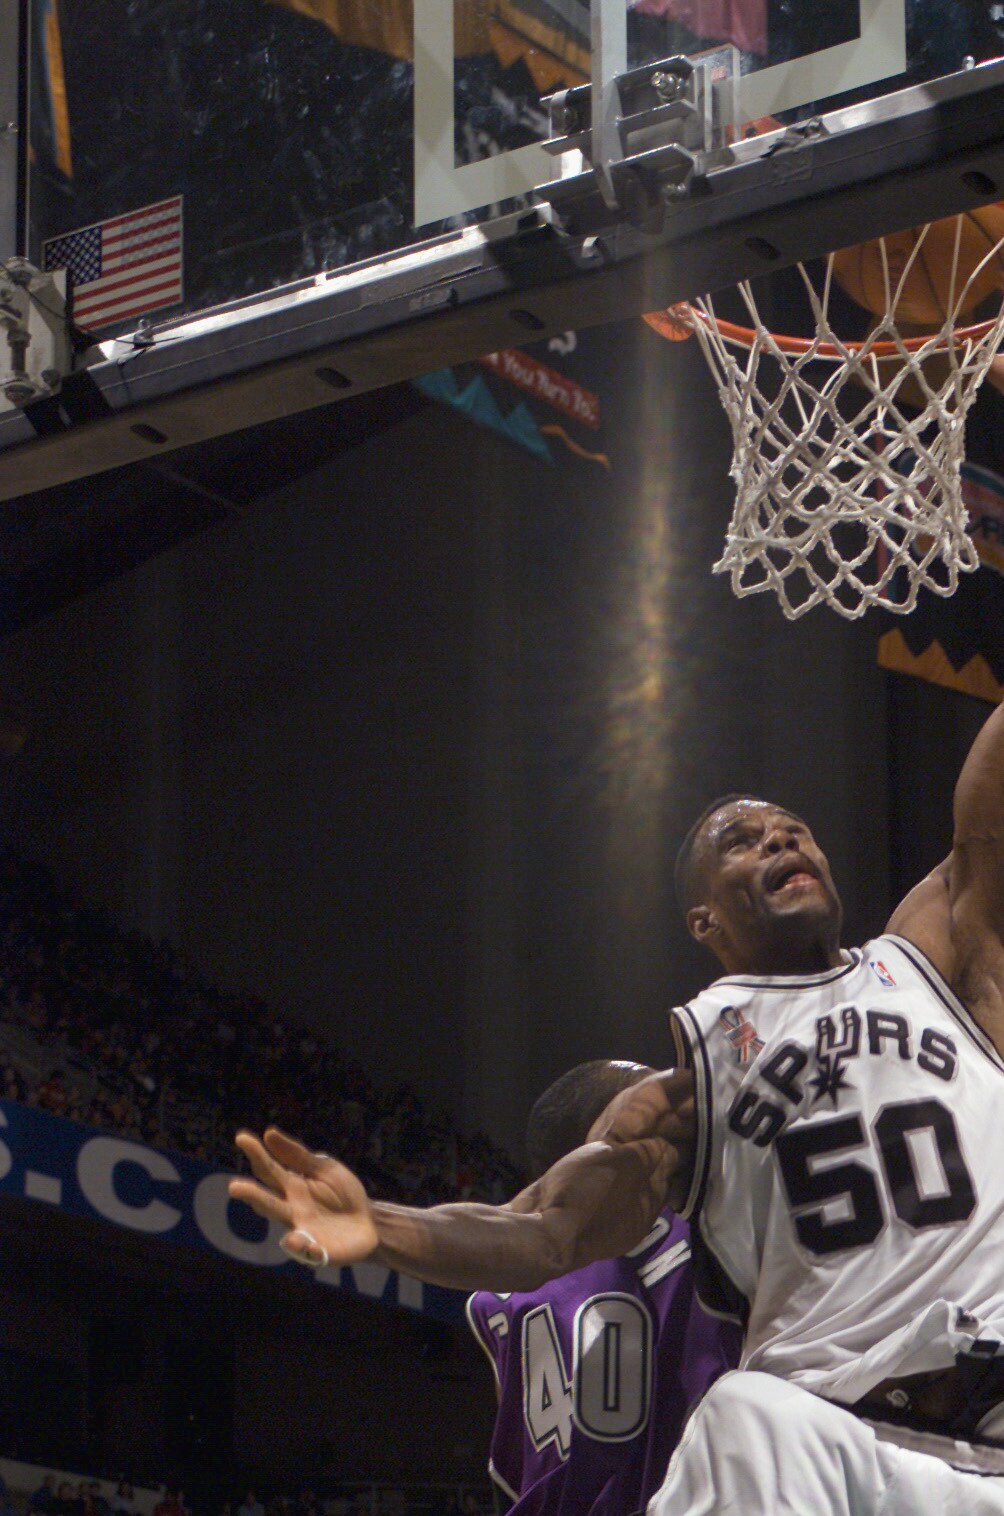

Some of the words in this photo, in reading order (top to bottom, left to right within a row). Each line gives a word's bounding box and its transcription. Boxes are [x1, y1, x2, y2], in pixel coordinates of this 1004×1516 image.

[728, 1004, 958, 1148] SPURS
[773, 1096, 979, 1256] 50
[522, 1292, 653, 1462] 40
